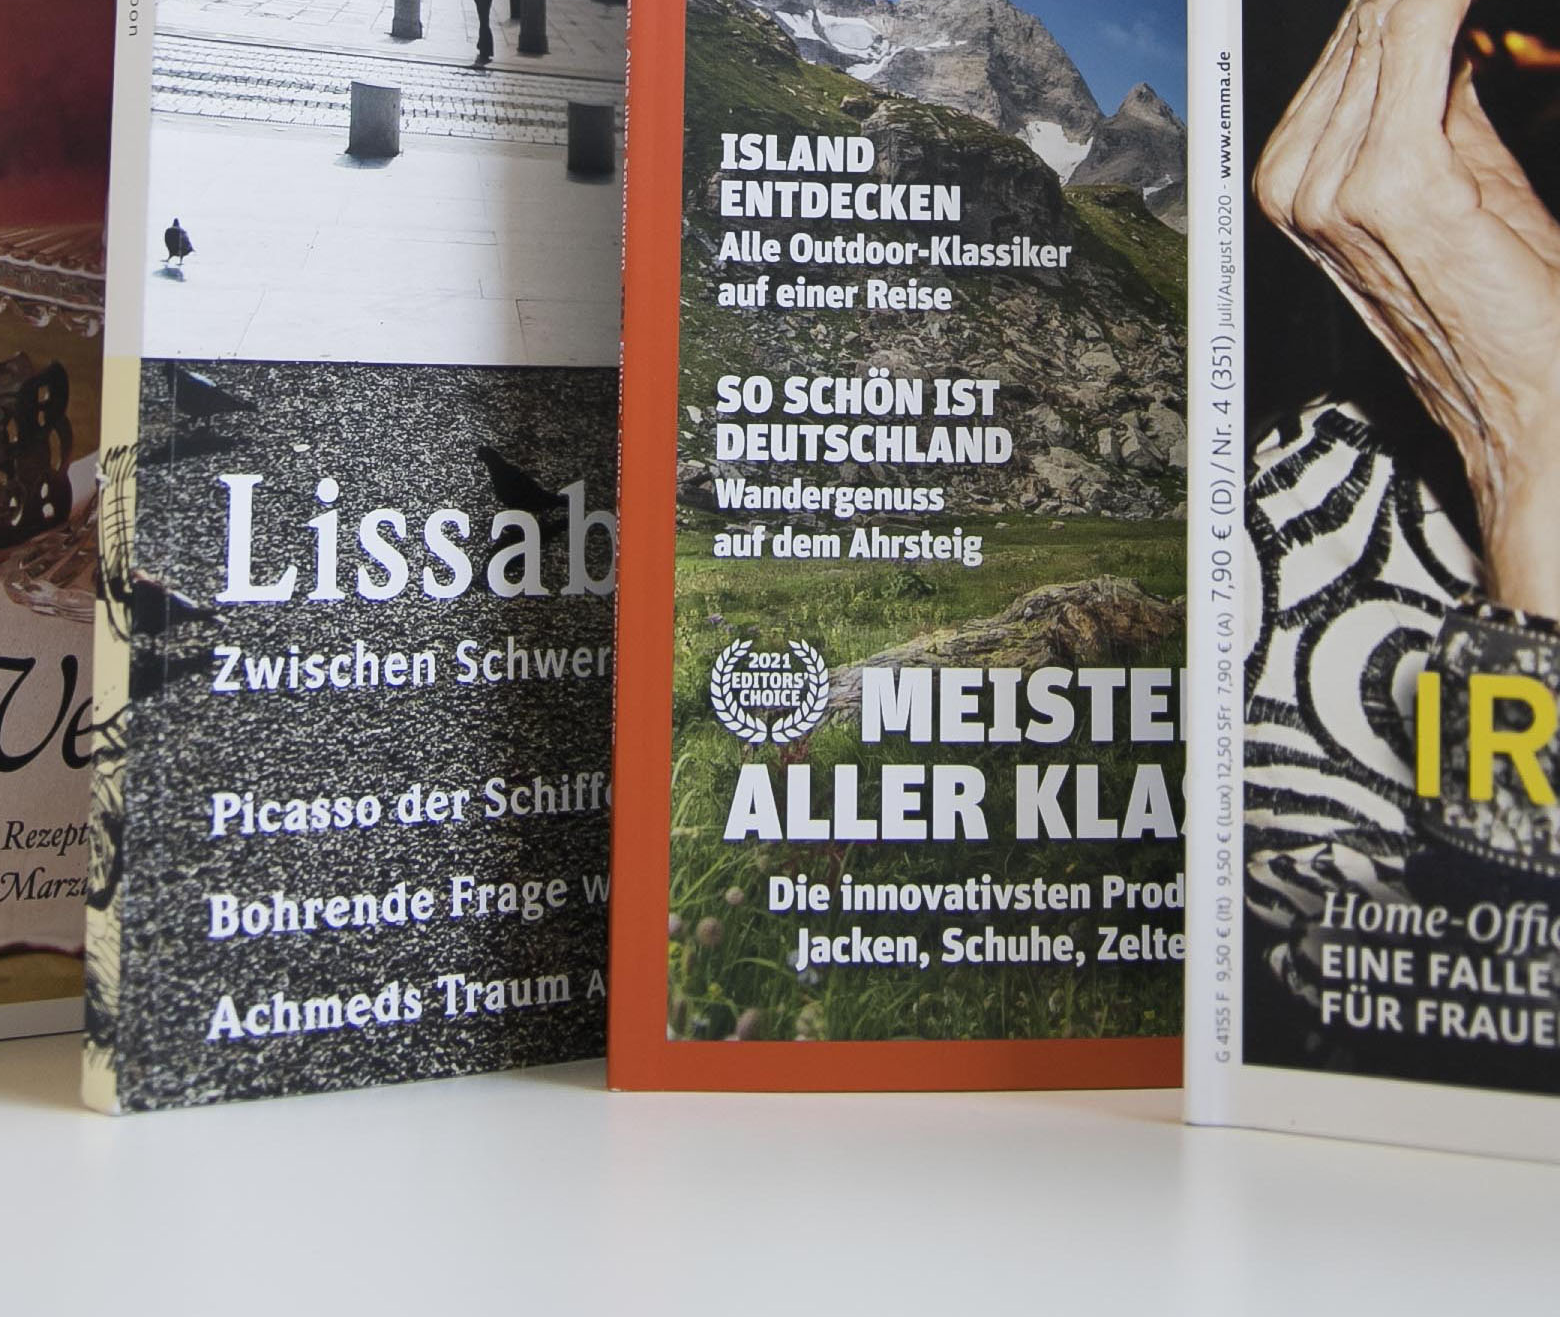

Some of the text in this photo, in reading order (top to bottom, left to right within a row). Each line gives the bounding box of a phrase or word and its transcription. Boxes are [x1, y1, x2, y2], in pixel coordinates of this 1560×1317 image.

[1217, 50, 1232, 179] www.emma.de
[720, 133, 875, 172] ISLAND
[720, 180, 961, 221] ENTDECKEN
[1218, 195, 1233, 235] 2020
[718, 231, 1072, 269] Alle Outdoor-Klassiker
[717, 276, 952, 311] auf einer Reise
[1218, 242, 1236, 329] Juli/August
[1211, 334, 1236, 390] (351)
[716, 367, 1000, 416] SO SCHÖN IST
[1212, 399, 1231, 415] 4
[715, 423, 1013, 464] DEUTSCHLAND
[1212, 423, 1232, 455] Nr.
[714, 478, 945, 518] Wandergenuss
[1211, 480, 1236, 515] (D)
[215, 473, 616, 603] Lissab
[713, 526, 983, 567] auf dem Ahrsteig
[1211, 525, 1233, 541] €
[1211, 550, 1236, 602] 7,90
[1217, 612, 1235, 637] (A)
[211, 637, 611, 692] Zwischen Schwer
[748, 652, 791, 669] 2021
[1217, 641, 1233, 653] €
[731, 672, 809, 689] EDITORS'
[1217, 659, 1234, 694] 7,90
[739, 689, 801, 707] CHOICE
[861, 666, 1187, 743] MEISTE
[1218, 736, 1234, 778] 12,50
[210, 790, 382, 837] Picasso
[397, 782, 470, 825] der
[723, 763, 1187, 841] ALLER KLA
[1216, 785, 1233, 829] (Lux)
[1217, 832, 1233, 846] €
[1217, 849, 1233, 886] 9,50
[207, 873, 568, 940] Bohrende Frage
[768, 873, 1185, 912] Die innovativsten Prod
[796, 925, 1186, 972] Jacken, Schuhe, Zelte
[1321, 943, 1552, 998] EINE FALLE
[206, 981, 424, 1041] Achmeds
[437, 968, 571, 1018] Traum
[1321, 984, 1403, 1032] FÜR
